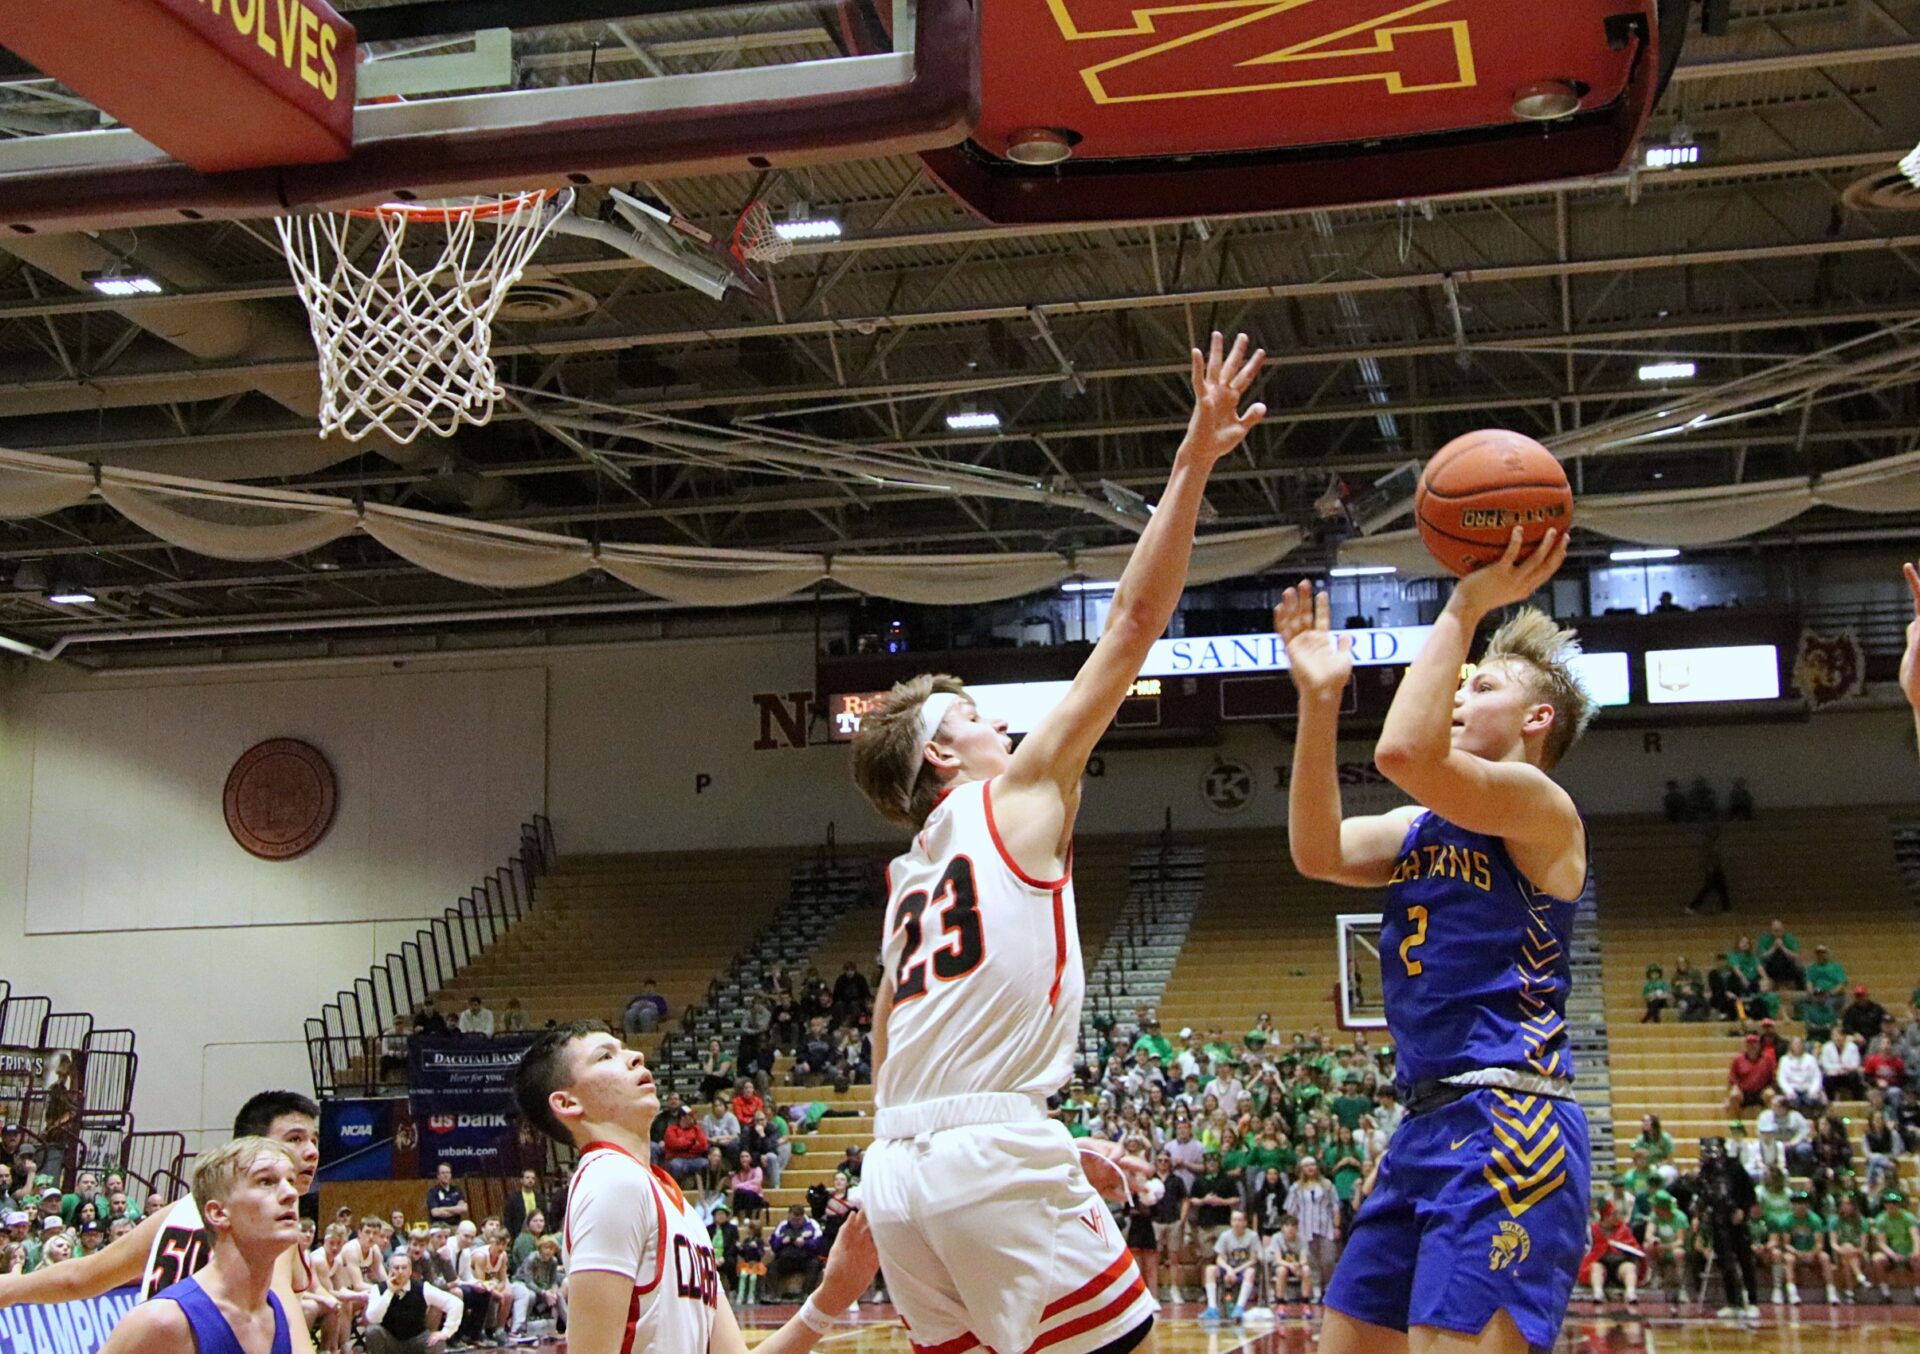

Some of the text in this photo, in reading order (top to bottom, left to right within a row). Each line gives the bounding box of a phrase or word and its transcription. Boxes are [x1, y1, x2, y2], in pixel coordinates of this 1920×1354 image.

[200, 0, 338, 101] OLVES
[1171, 631, 1399, 671] SANFRD
[752, 690, 815, 751] N
[696, 773, 711, 794] P
[892, 853, 985, 1008] 23
[1399, 904, 1429, 977] 2
[340, 1124, 373, 1137] NCAA
[458, 1114, 507, 1128] bank
[437, 1146, 498, 1157] usbank.com
